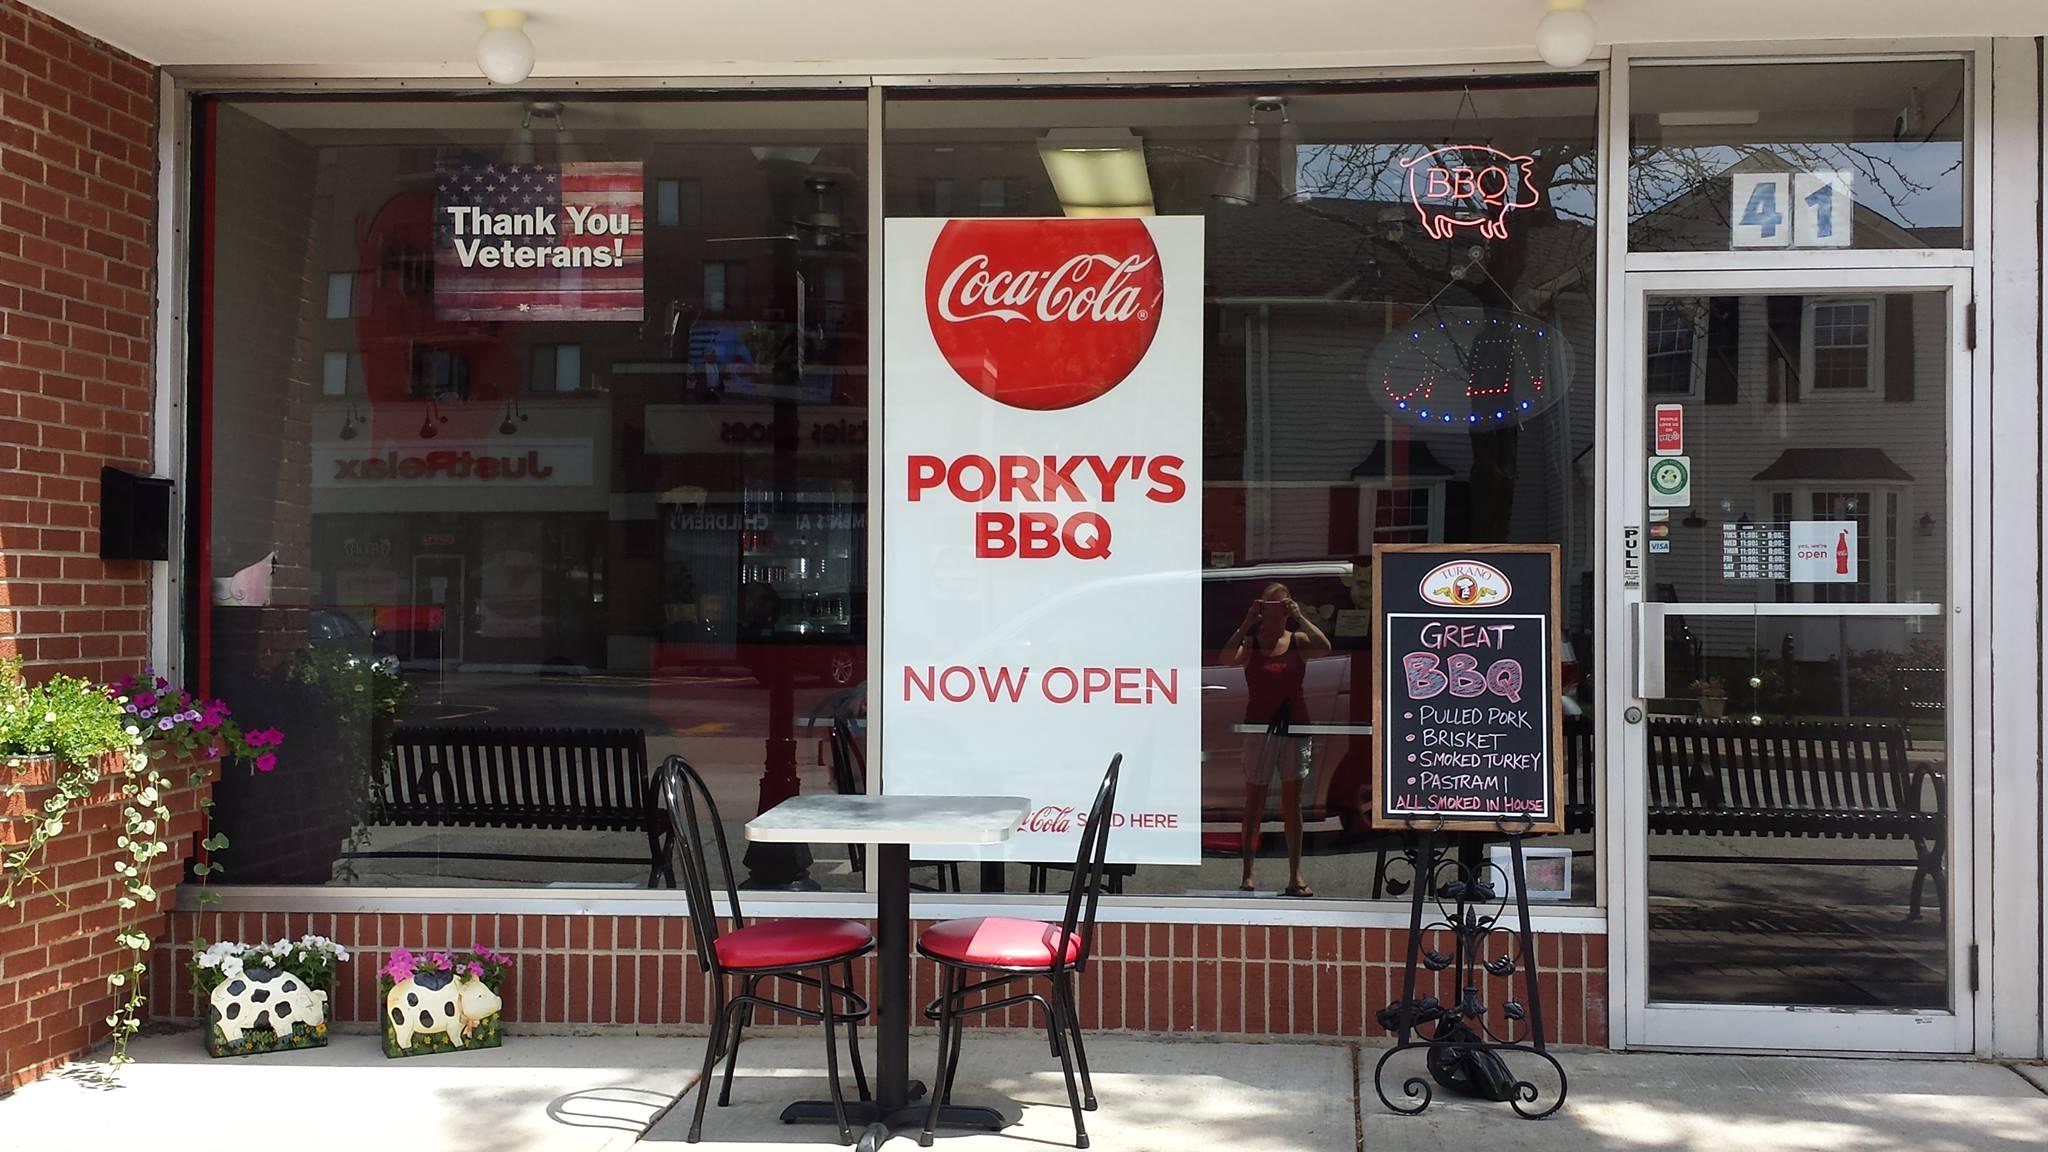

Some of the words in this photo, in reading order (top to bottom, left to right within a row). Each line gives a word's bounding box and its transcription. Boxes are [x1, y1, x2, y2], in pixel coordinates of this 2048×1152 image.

[1427, 166, 1508, 205] BBQ
[447, 206, 557, 236] Thank
[565, 206, 630, 236] You
[1738, 181, 1836, 239] 41
[453, 238, 624, 268] Veterans!
[938, 254, 1154, 323] Coca-Cola
[907, 454, 1187, 503] PORKY'S
[975, 511, 1112, 560] BBQ
[1624, 530, 1639, 568] PULL
[1797, 551, 1828, 560] open
[1439, 566, 1492, 581] TURANO
[1420, 622, 1516, 650] GREAT
[903, 665, 1030, 703] NOW
[1041, 666, 1178, 704] OPEN
[1402, 651, 1523, 704] BBQ
[1419, 706, 1483, 726] PULLED
[1488, 707, 1533, 730] PORK
[1422, 730, 1508, 751] BRISKET
[1419, 751, 1481, 769] SMOKED
[1481, 752, 1542, 772] TURKEY
[1419, 772, 1509, 793] PASTRAMI
[1395, 794, 1426, 810] ALL
[1427, 794, 1481, 811] SMOKED
[1485, 797, 1500, 811] IN
[1503, 797, 1545, 812] HOUSE
[1130, 813, 1178, 828] HERE
